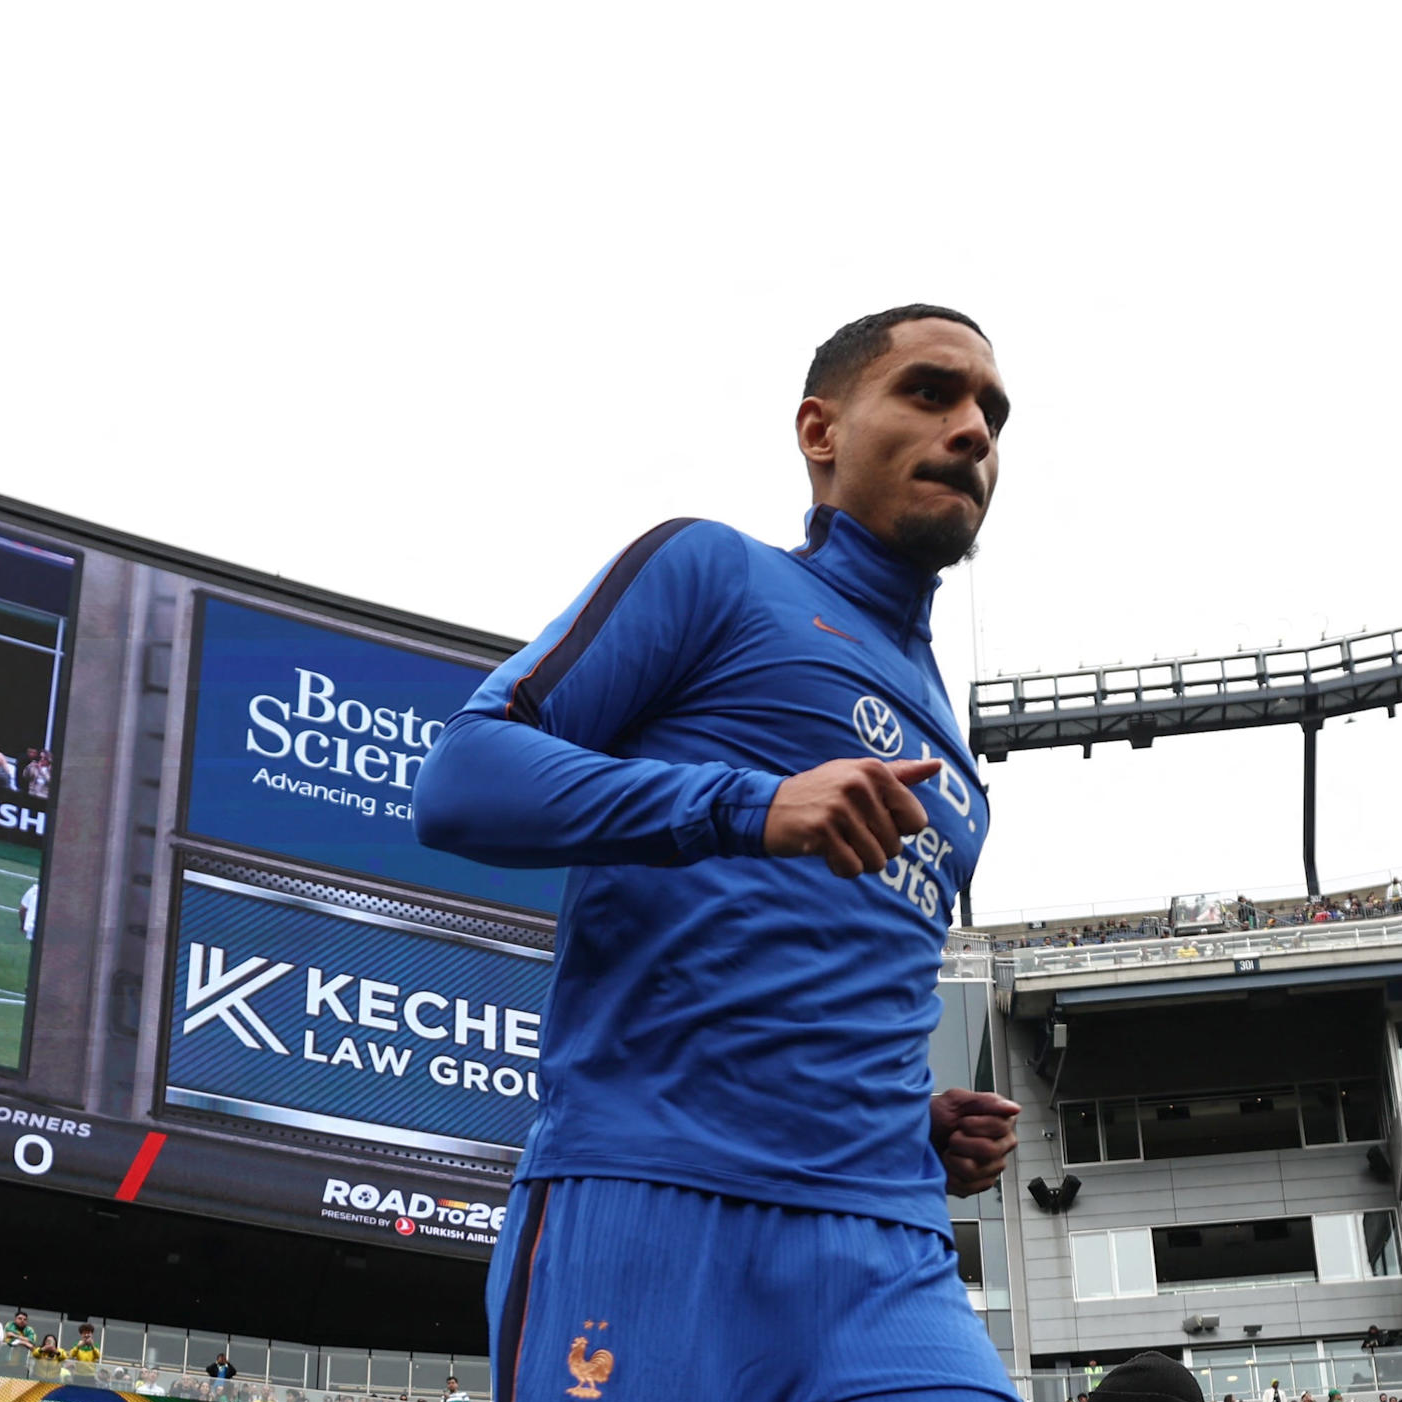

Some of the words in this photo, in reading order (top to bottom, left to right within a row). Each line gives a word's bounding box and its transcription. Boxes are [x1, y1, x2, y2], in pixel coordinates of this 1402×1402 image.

[252, 768, 377, 816] Advancing
[384, 801, 414, 820] sci
[304, 1031, 412, 1077] LAW
[321, 1208, 377, 1226] PRESENTED
[378, 1218, 391, 1227] BY
[322, 1178, 436, 1219] ROAD
[418, 1224, 464, 1240] TURKISH
